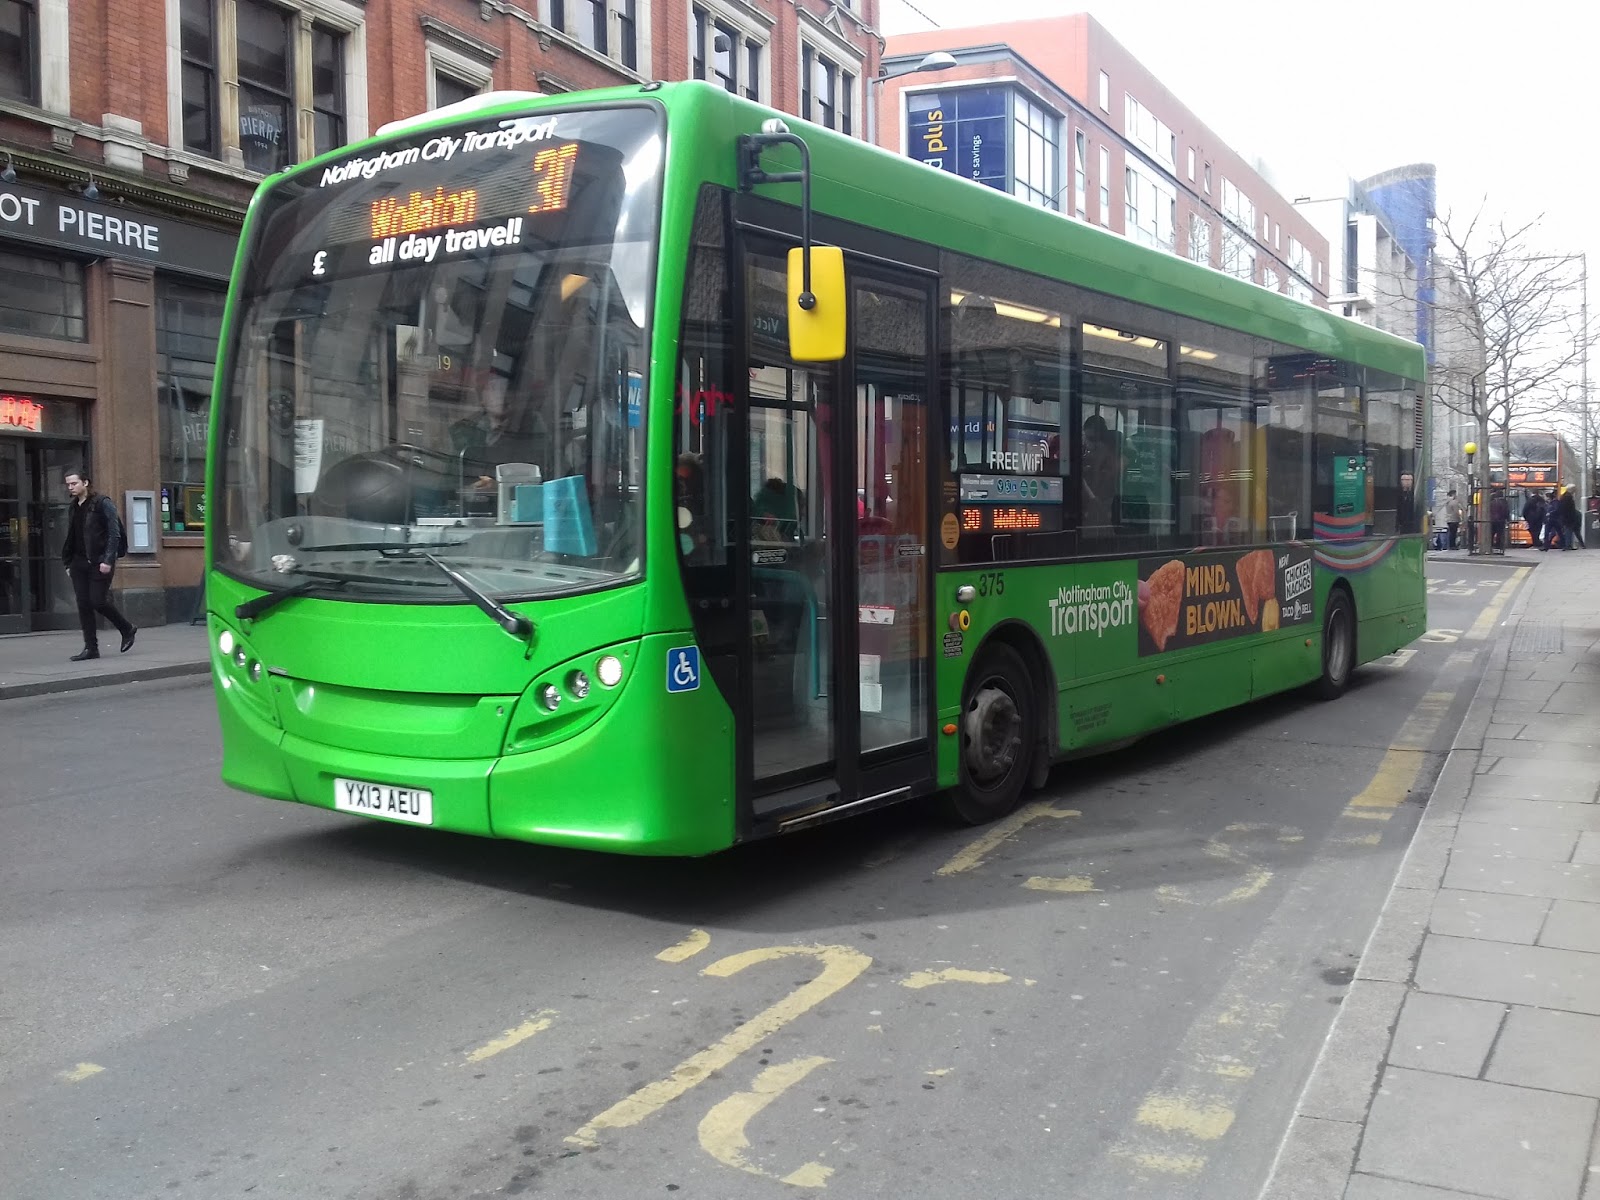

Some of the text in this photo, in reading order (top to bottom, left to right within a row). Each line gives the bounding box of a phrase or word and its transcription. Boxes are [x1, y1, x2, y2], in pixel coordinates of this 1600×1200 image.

[240, 116, 281, 145] PIERRE
[923, 110, 948, 152] plus
[320, 117, 558, 187] Nottingham City Transport
[972, 134, 982, 169] savings
[0, 193, 160, 252] OT PIERRE
[371, 186, 477, 239] Wollaton
[312, 217, 523, 275] £ all day travel!
[950, 421, 981, 433] wrld
[990, 450, 1044, 472] FREE WiFi
[962, 508, 981, 529] 30
[993, 508, 1040, 528] Wollaton
[979, 572, 1005, 597] 375
[1186, 564, 1230, 597] MIND.
[1286, 561, 1311, 584] CHICKEN
[1286, 574, 1311, 600] NACHOS
[1058, 580, 1130, 607] Nottingham City
[1282, 603, 1312, 617] TACO BELL
[1049, 590, 1134, 638] Transport
[1186, 598, 1246, 635] BLOWN.
[345, 782, 420, 815] YX13 AEU
